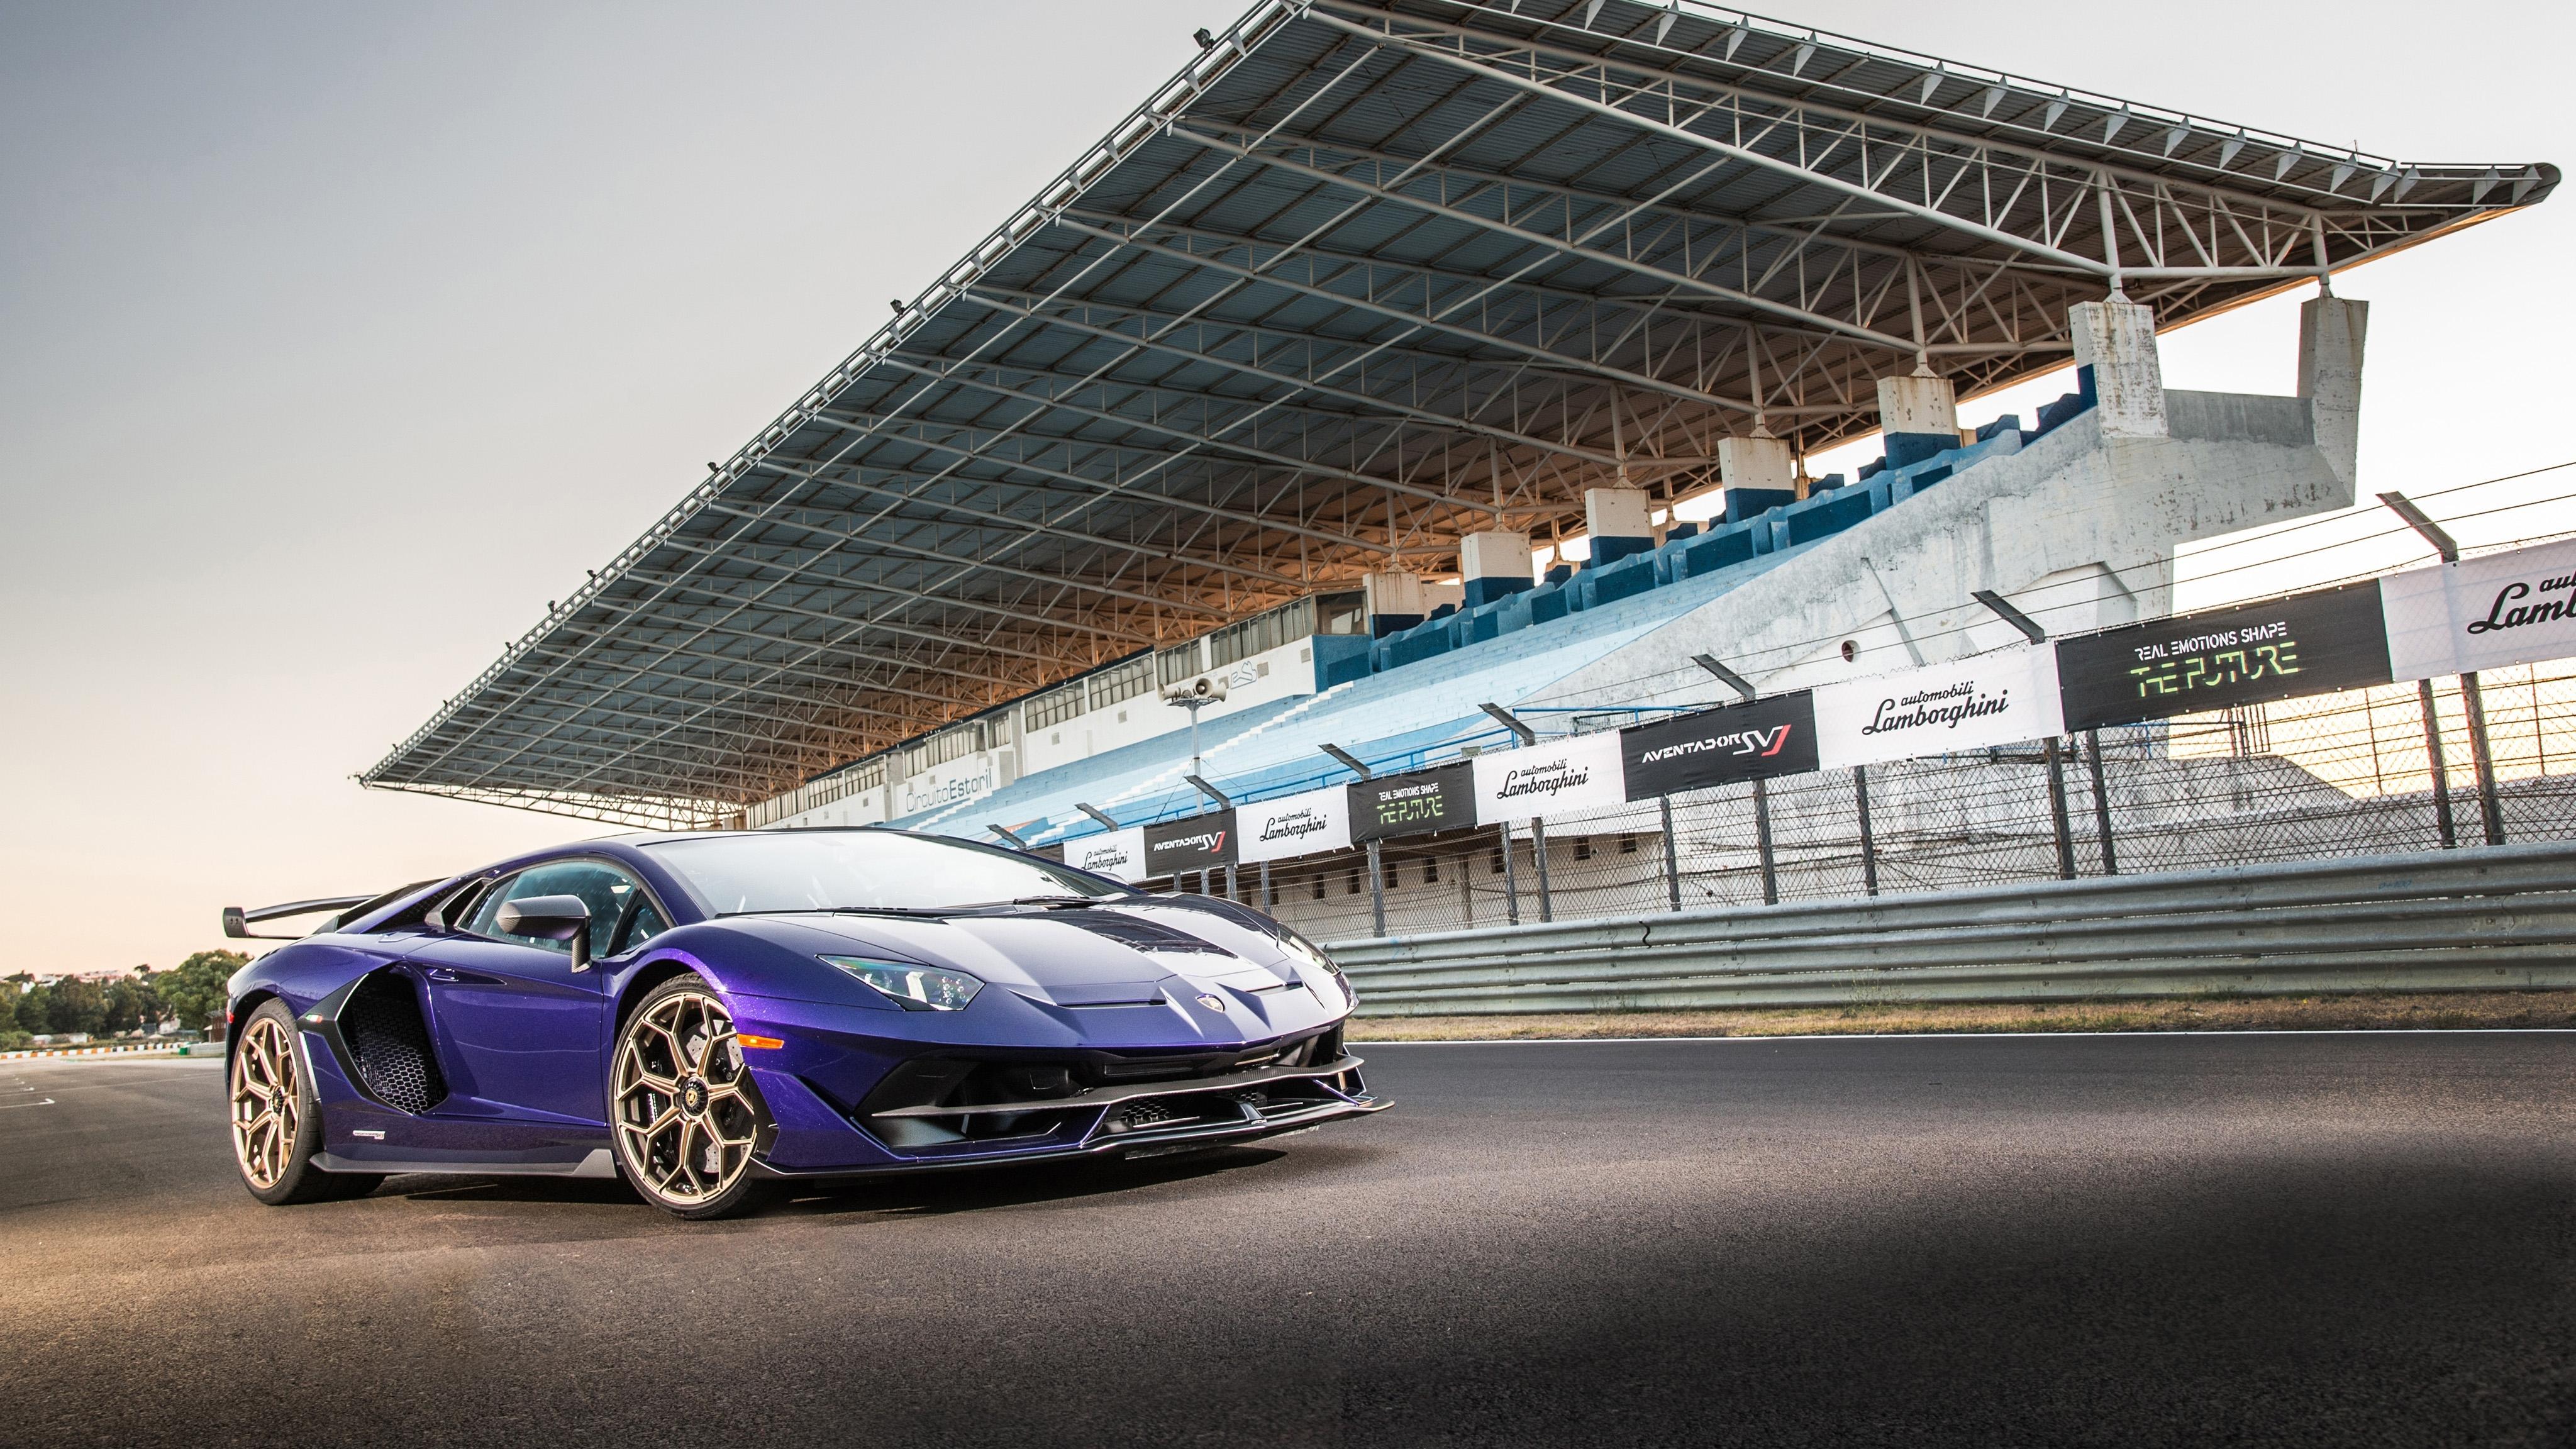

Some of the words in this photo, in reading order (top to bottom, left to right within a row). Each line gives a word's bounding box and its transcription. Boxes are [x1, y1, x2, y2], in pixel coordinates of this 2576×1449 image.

[2135, 644, 2168, 661] REAL
[2171, 631, 2238, 655] EMOTIONS
[2241, 621, 2287, 643] SHAPE
[1901, 680, 1974, 706] automobili
[1862, 689, 2009, 735] Lamborghini
[1642, 733, 1741, 763] AVENTADOR
[1733, 724, 1792, 757] SVJ
[1521, 758, 1567, 777] automobili
[906, 768, 992, 813] CircuitoEstoril
[1379, 791, 1392, 801] REAL
[1393, 786, 1420, 799] EMOTIONS
[1420, 782, 1439, 795] SHAPE
[1497, 766, 1589, 799] Lamborghini
[1259, 814, 1327, 841] Lamborghini
[1277, 808, 1311, 823] automobili
[1153, 835, 1202, 852] AVENTADOR
[1197, 830, 1226, 853] SVJ
[1081, 852, 1128, 871] Lamborghini
